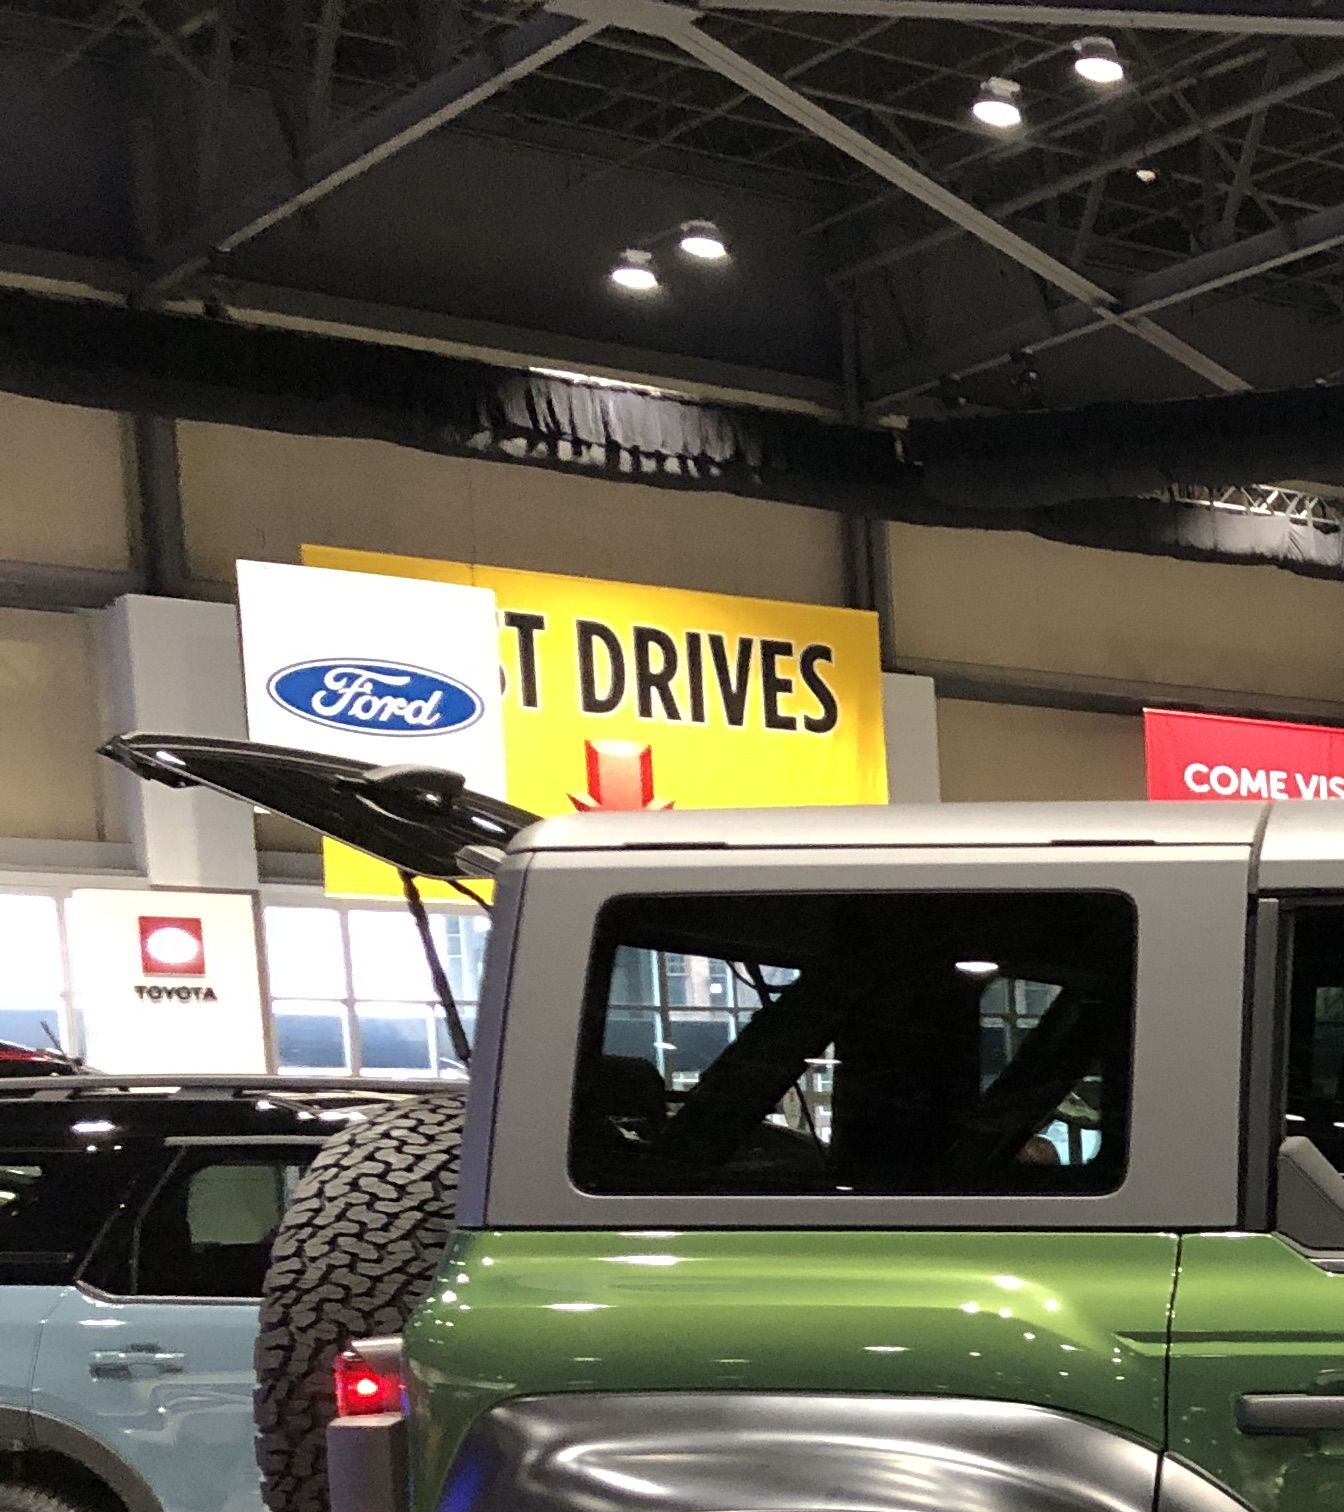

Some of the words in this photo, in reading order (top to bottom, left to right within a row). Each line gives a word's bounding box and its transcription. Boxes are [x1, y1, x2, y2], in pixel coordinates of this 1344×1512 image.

[499, 611, 545, 708] T
[576, 619, 838, 734] DRIVES
[312, 667, 442, 726] Ford
[1184, 763, 1288, 799] COME
[134, 985, 218, 1002] TOYOTA
